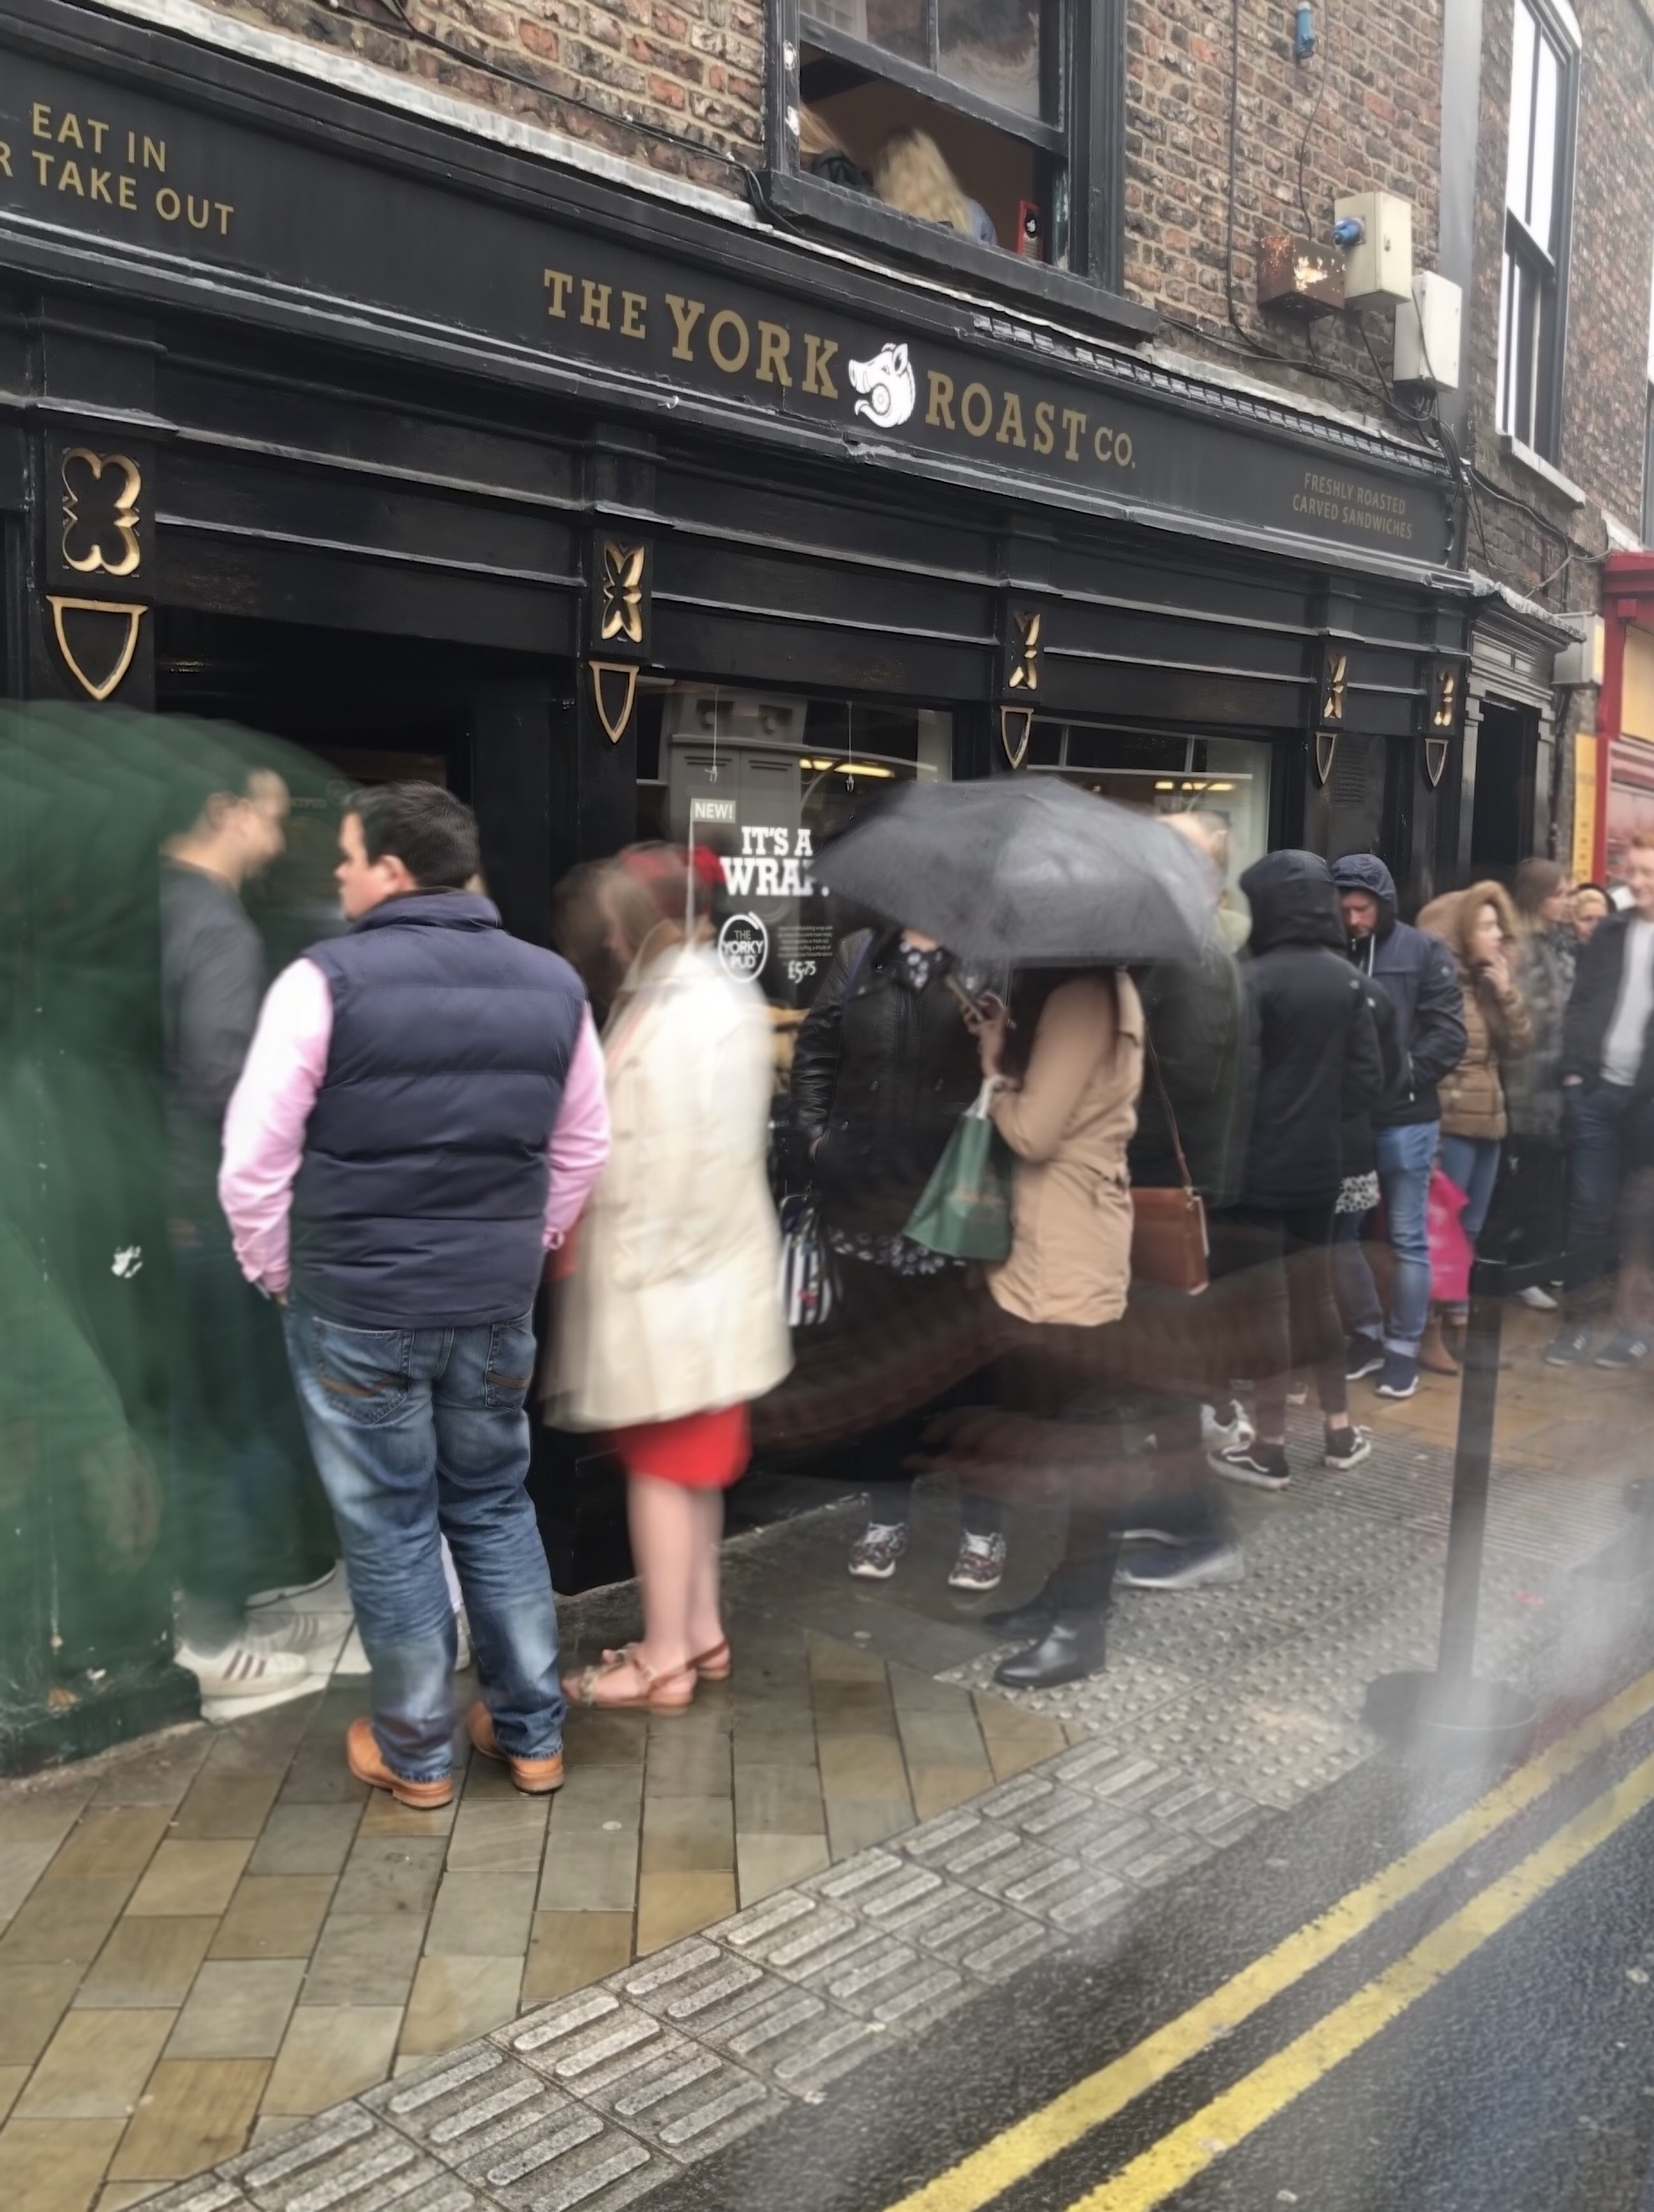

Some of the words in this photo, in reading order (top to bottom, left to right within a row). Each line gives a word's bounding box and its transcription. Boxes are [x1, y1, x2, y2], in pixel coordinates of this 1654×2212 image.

[33, 102, 109, 154] EAT
[128, 131, 166, 172] IN
[32, 150, 137, 211] TAKE
[156, 187, 234, 235] OUT
[544, 268, 646, 340] THE
[665, 293, 838, 400] YORK
[925, 370, 1087, 461] ROAST
[1094, 426, 1136, 469] CO.
[1304, 472, 1353, 500] FRESHLY
[1357, 487, 1405, 514] ROASTED
[1293, 494, 1338, 520] CARVED
[1343, 507, 1412, 539] SANDWICHES
[695, 802, 733, 819] NEW!
[741, 826, 789, 856] IT'S
[794, 828, 813, 856] A
[719, 857, 829, 897] WRA
[722, 940, 763, 955] YORKY
[734, 930, 751, 939] THE
